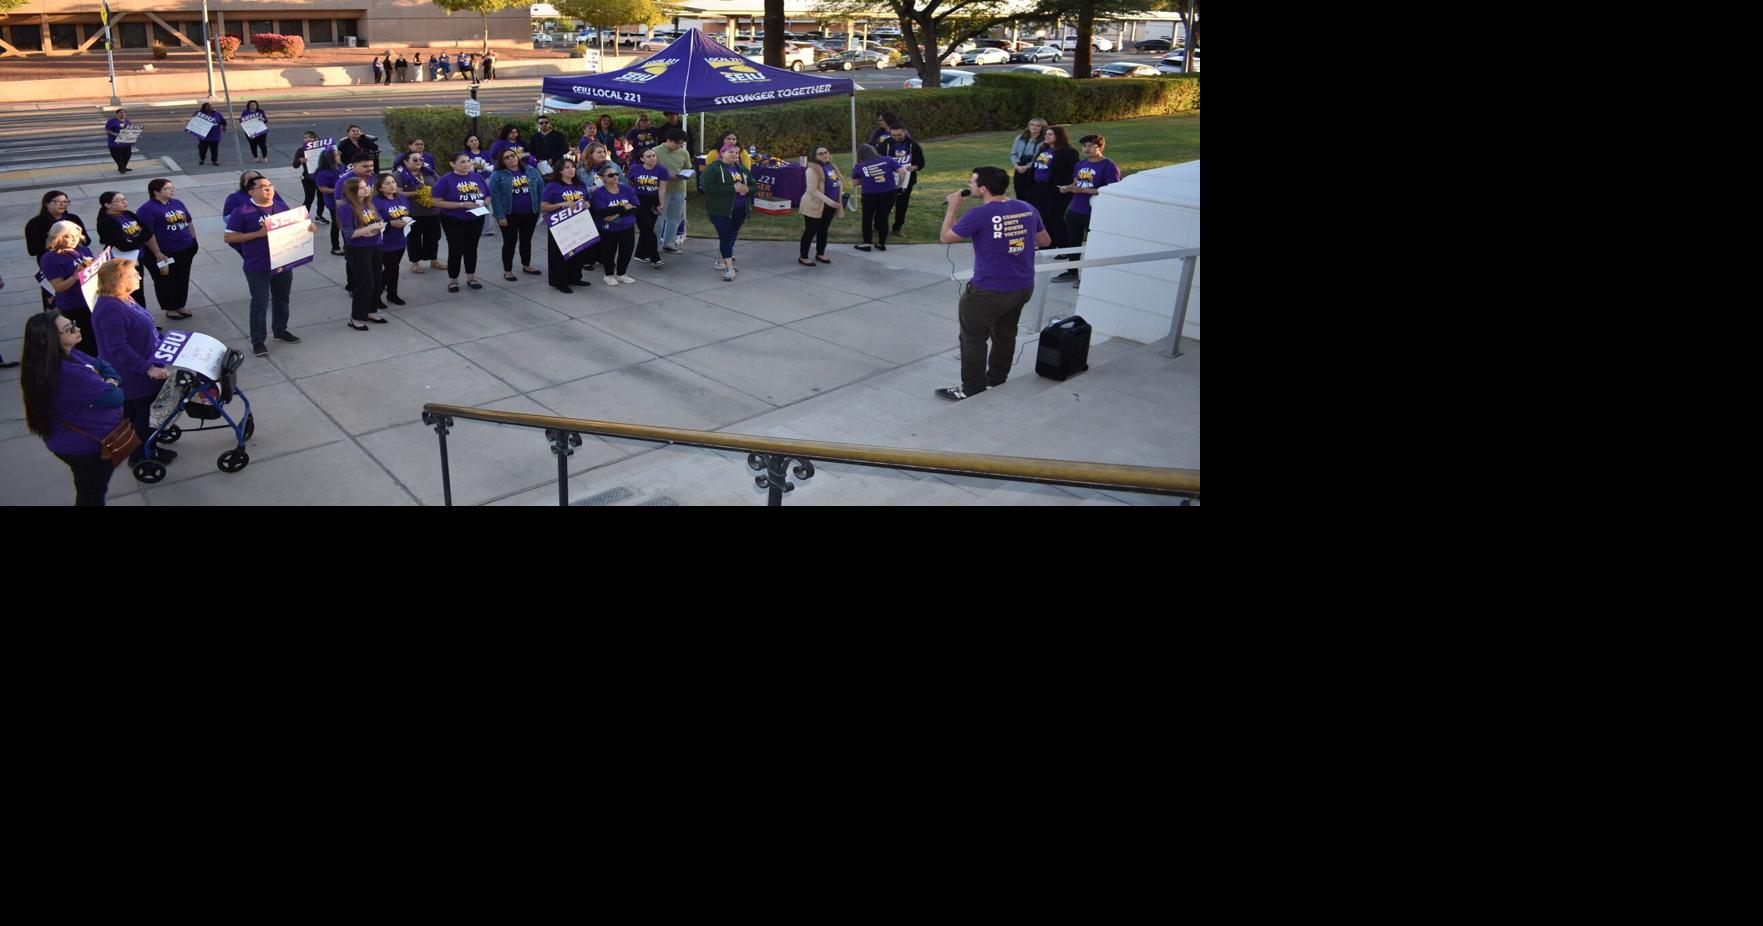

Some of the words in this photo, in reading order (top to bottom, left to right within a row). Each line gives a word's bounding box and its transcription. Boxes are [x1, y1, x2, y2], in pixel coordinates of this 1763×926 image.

[617, 72, 659, 81] SEIU
[723, 72, 766, 82] SEIU
[572, 85, 591, 96] SEIU
[592, 89, 623, 100] LOCAL
[624, 92, 642, 103] 221
[714, 91, 775, 105] STRONGER
[777, 84, 832, 98] TOGETHER
[306, 138, 333, 150] SEIU
[757, 175, 776, 184] 221
[991, 215, 1003, 239] OUR
[154, 332, 187, 361] SEIU
